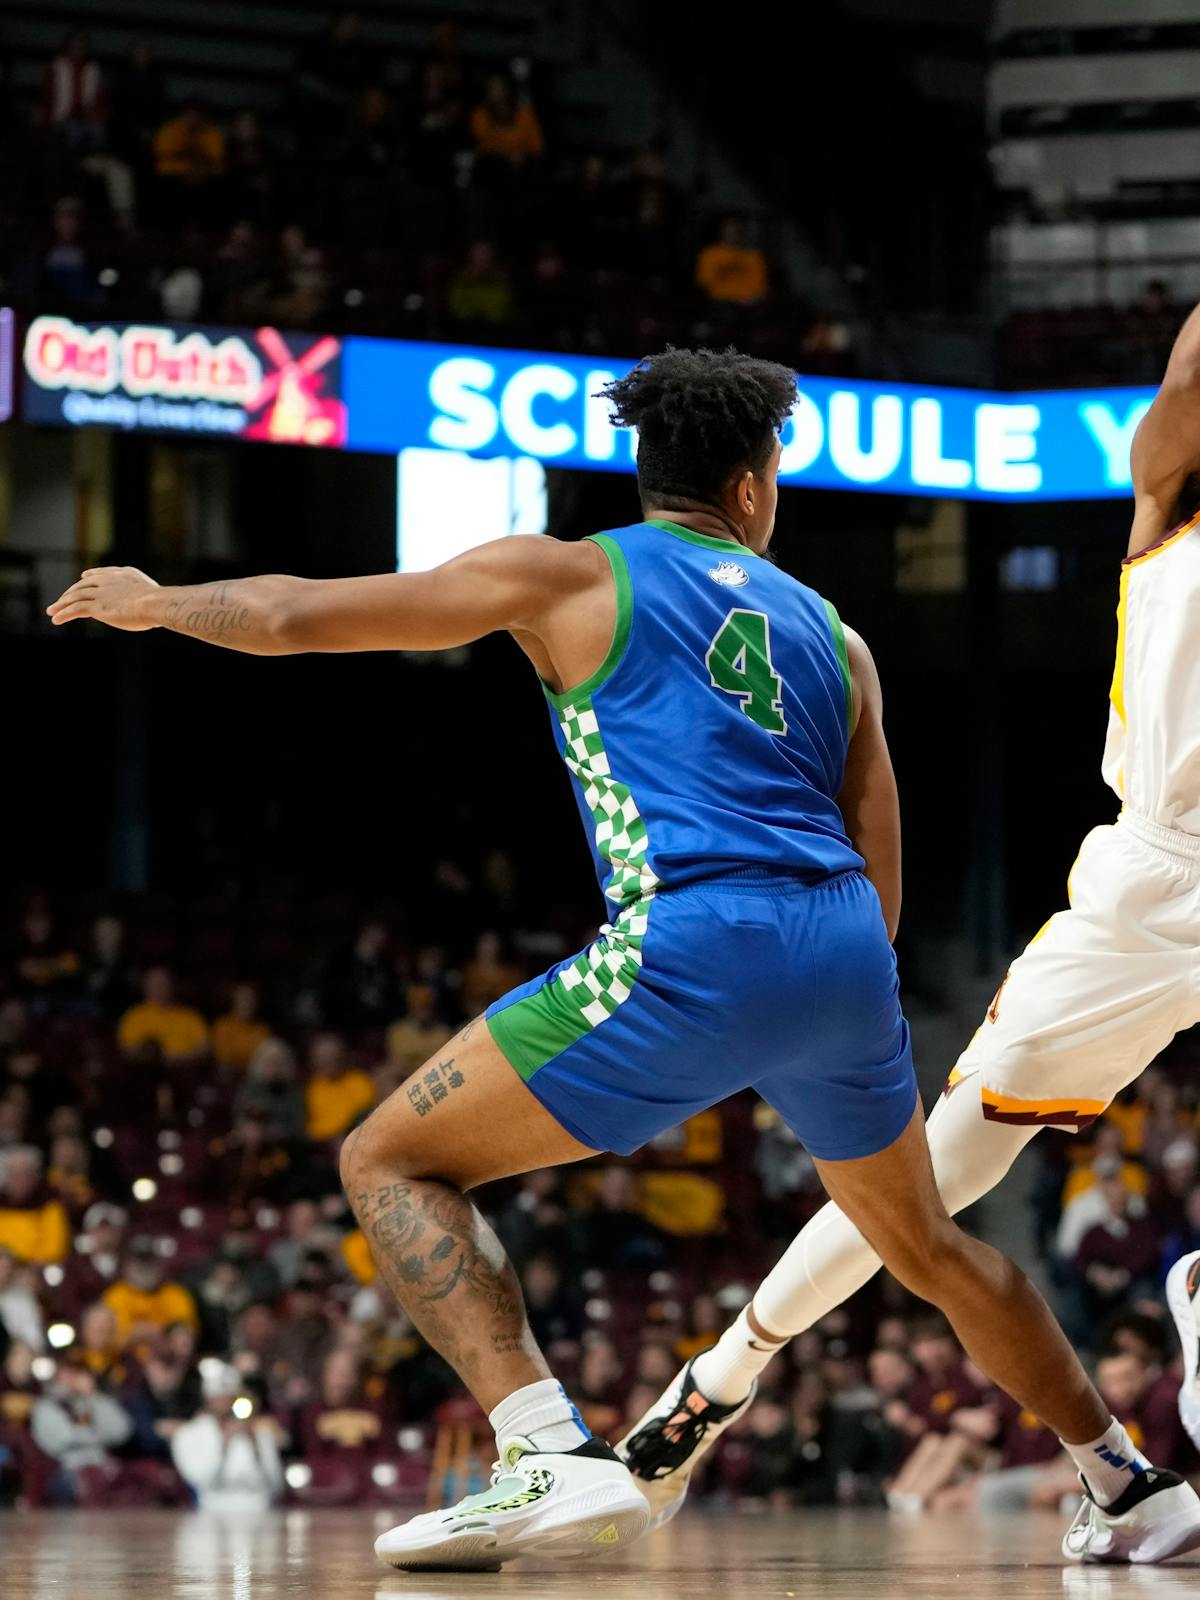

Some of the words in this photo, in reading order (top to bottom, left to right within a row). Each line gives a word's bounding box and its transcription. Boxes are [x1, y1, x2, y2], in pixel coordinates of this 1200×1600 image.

[29, 321, 116, 388] Old
[124, 331, 258, 399] Dutch
[428, 356, 1043, 493] SCHDULE
[705, 607, 788, 736] 4
